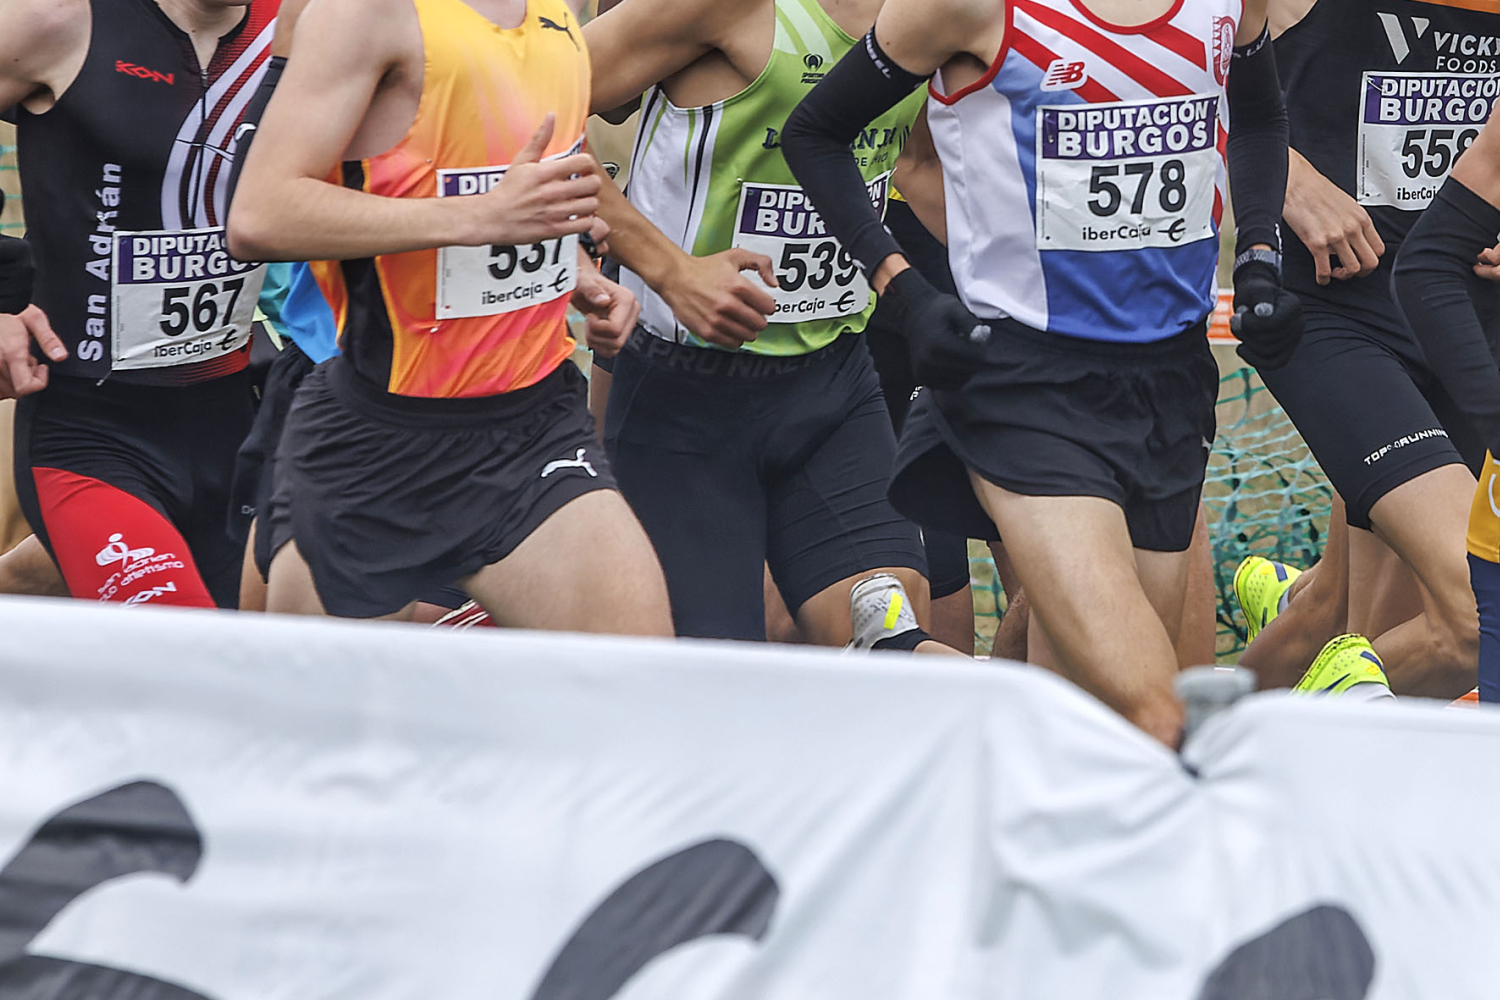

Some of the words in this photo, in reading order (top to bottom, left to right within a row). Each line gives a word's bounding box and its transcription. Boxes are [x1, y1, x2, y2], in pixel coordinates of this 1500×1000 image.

[1436, 56, 1497, 73] FOODS
[1058, 100, 1209, 131] DIPUTACIÓN
[1379, 97, 1498, 122] BURGO
[1058, 121, 1208, 157] BURGOS
[1087, 159, 1187, 217] 578
[1396, 186, 1437, 201] iberCaj
[85, 162, 122, 281] Adrián
[754, 208, 827, 236] BUR
[1082, 224, 1151, 242] iberCaja
[132, 236, 227, 257] DIPUTA
[775, 241, 859, 293] 539
[159, 276, 245, 338] 567
[481, 281, 543, 305] iberCaja
[77, 293, 107, 362] San
[153, 338, 213, 359] iberCaja
